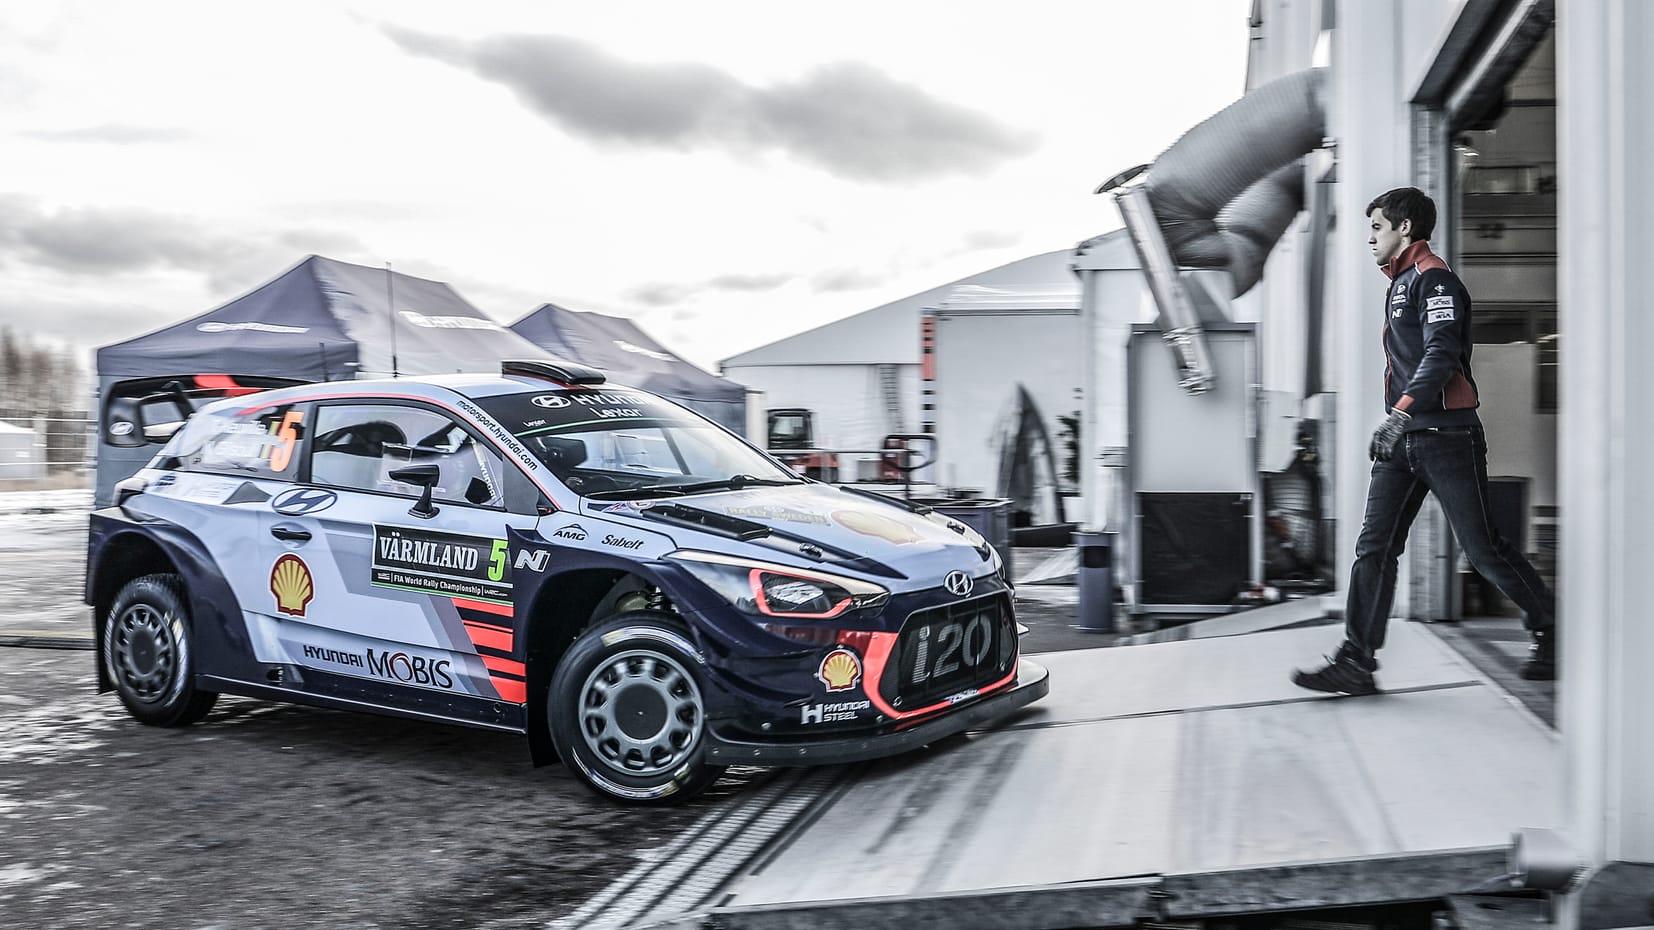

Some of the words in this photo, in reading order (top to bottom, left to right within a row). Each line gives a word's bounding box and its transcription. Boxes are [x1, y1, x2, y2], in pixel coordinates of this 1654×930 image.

[270, 411, 304, 472] 5
[456, 399, 538, 471] motorsport.hyundai.com
[379, 531, 479, 571] VÄRMLAND
[487, 539, 509, 581] 5
[601, 534, 645, 550] Sabelt
[394, 574, 404, 583] FIA
[405, 575, 422, 585] World
[423, 579, 439, 589] Rally
[439, 581, 481, 595] Championship
[303, 644, 364, 668] HYUNDAI
[366, 648, 453, 689] MOBIS
[911, 614, 993, 684] i20
[824, 699, 870, 712] HYUNDAI
[824, 710, 859, 722] STEEL
